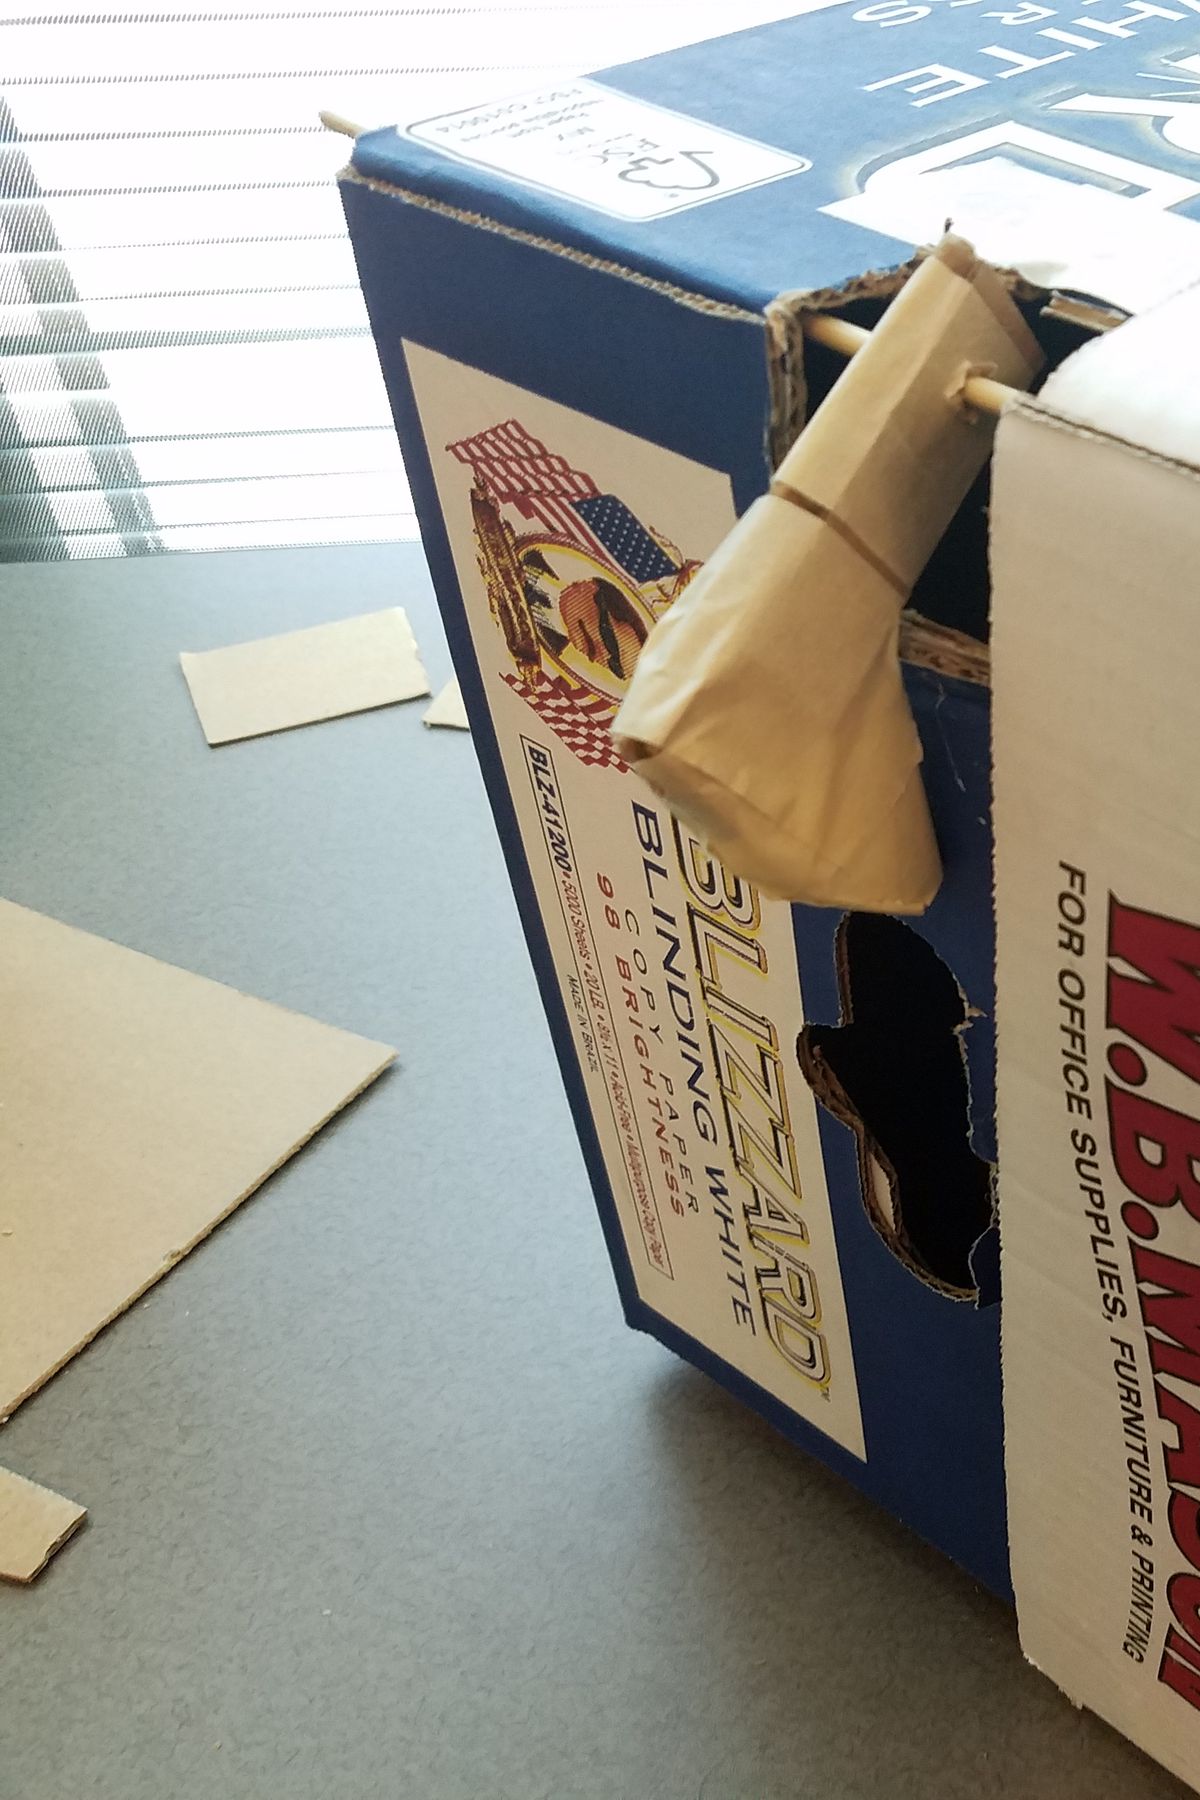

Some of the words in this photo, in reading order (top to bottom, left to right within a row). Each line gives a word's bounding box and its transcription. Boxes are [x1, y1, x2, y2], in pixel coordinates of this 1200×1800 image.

[527, 744, 572, 871] BLZ-41200
[561, 879, 582, 915] 5000
[570, 915, 590, 958] Sheets
[1057, 860, 1087, 957] FOR
[567, 974, 583, 1010] MADE
[581, 1031, 598, 1072] BRAZIL
[583, 969, 599, 989] 20
[597, 872, 621, 931] 98
[615, 955, 684, 1217] BRIGHTNESS
[625, 909, 663, 1044] COPY
[659, 1071, 699, 1214] PAPER
[631, 800, 718, 1147] BLINDING
[705, 1165, 756, 1336] WHITE
[1058, 968, 1093, 1121] OFFICE
[1070, 1128, 1128, 1323] SUPPLIES,
[1110, 1335, 1153, 1525] FURNITURE
[1130, 1525, 1154, 1547] &
[1122, 1549, 1155, 1664] PRINTING
